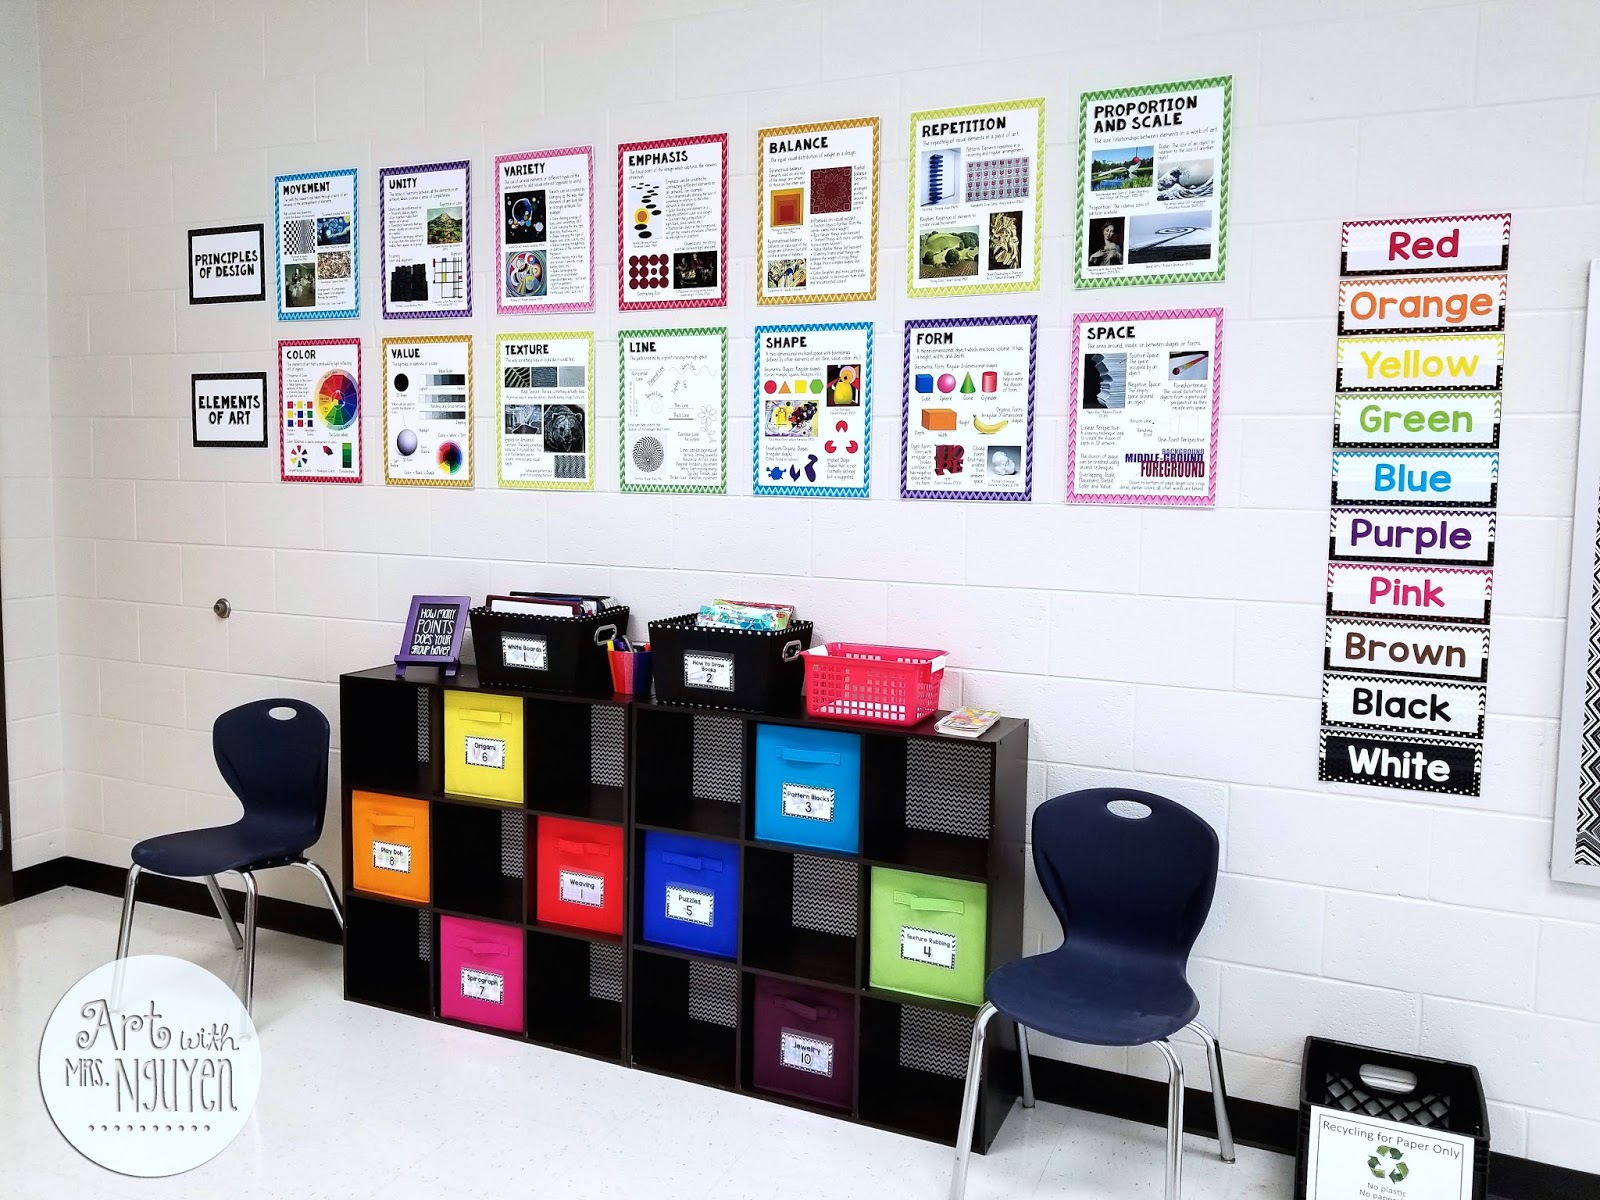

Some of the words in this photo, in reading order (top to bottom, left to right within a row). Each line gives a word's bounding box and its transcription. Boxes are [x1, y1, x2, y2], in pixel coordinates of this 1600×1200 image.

[1094, 96, 1197, 118] PROPORTION
[922, 116, 1005, 137] REPETITION
[1094, 119, 1126, 133] AND
[1132, 113, 1182, 129] SCALE
[770, 137, 828, 153] BALANCE
[629, 150, 688, 166] EMPHASIS
[504, 163, 545, 176] VARIETY
[283, 182, 330, 195] MOVEMENT
[389, 178, 417, 189] UNITY
[1388, 229, 1459, 261] Red
[195, 250, 258, 266] PRINCIPLES
[200, 267, 211, 279] OF
[216, 263, 255, 277] DESIGN
[1351, 291, 1493, 324] Orange
[917, 332, 953, 345] FORM
[1087, 326, 1135, 339] SPACE
[630, 342, 656, 352] LINE
[766, 337, 807, 348] SHAPE
[287, 350, 316, 359] COLOR
[391, 349, 420, 359] VALUE
[505, 344, 549, 355] TEXTURE
[1360, 350, 1479, 380] Yellow
[198, 395, 260, 409] ELEMENTS
[209, 411, 223, 424] OF
[229, 411, 251, 424] ART
[1360, 405, 1473, 432] Green
[1141, 461, 1204, 477] FOREGROUND
[1375, 464, 1451, 492] Blue
[1350, 518, 1472, 554] Purple
[1370, 576, 1445, 607] Pink
[417, 620, 455, 634] POINTS
[523, 645, 542, 653] Boards
[1345, 632, 1466, 668] Brown
[706, 673, 712, 683] 2
[1353, 688, 1451, 722] Black
[475, 742, 496, 751] Origami
[482, 752, 488, 762] 6
[1348, 745, 1450, 782] White
[787, 791, 809, 799] Pattern
[811, 794, 829, 802] Blocks
[805, 802, 811, 812] 3
[381, 847, 392, 856] Play
[390, 857, 394, 866] 8
[570, 879, 595, 890] Weaving
[679, 895, 701, 905] Puzzles
[686, 906, 693, 916] 5
[907, 934, 927, 942] Texture
[929, 938, 950, 948] Rubbing
[924, 946, 931, 957] 4
[467, 975, 498, 986] Spirograph
[480, 986, 484, 995] 7
[793, 1042, 820, 1055] Jewelry
[801, 1053, 811, 1064] 10
[1323, 1121, 1373, 1142] Recycling
[1377, 1132, 1393, 1143] for
[1397, 1136, 1429, 1152] Paper
[1433, 1145, 1460, 1160] Only
[1359, 1189, 1371, 1197] No
[1368, 1182, 1378, 1190] No
[1381, 1186, 1406, 1197] plastic
